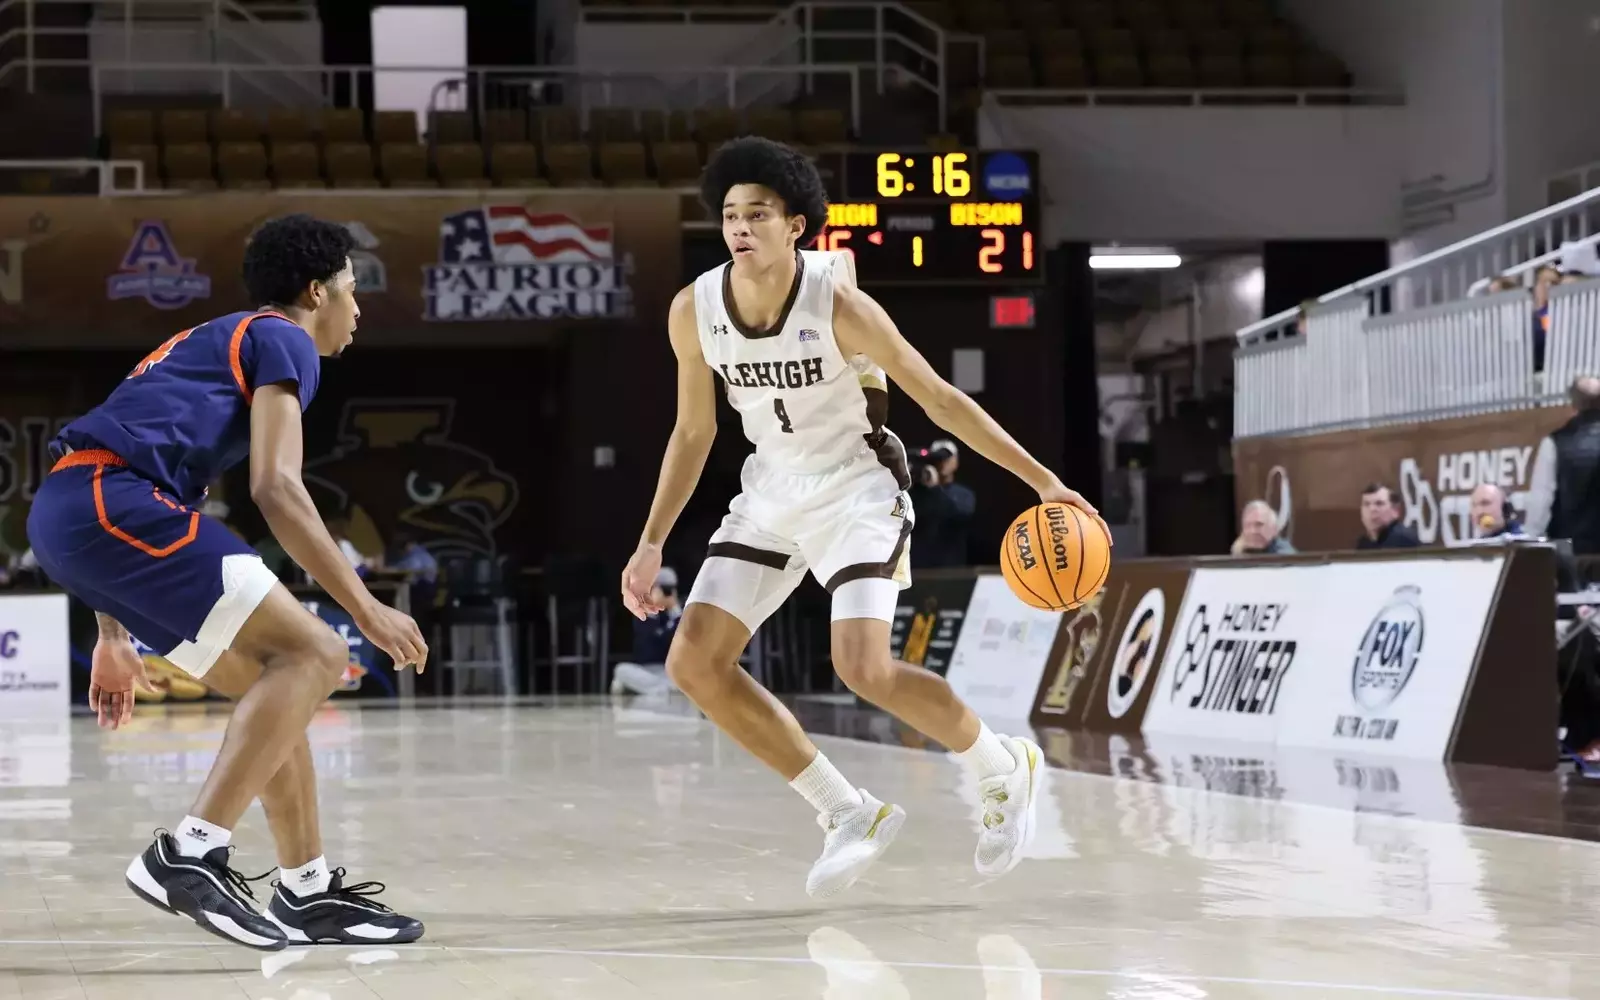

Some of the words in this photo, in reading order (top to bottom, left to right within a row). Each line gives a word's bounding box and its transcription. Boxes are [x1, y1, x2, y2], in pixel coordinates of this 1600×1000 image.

[877, 153, 970, 197] 6:16
[950, 203, 1022, 225] BISON
[912, 236, 923, 266] 1
[979, 229, 1032, 272] 21
[422, 263, 632, 292] PATRIOT
[422, 290, 634, 319] LEAGUE
[720, 357, 824, 389] LEHIGH
[774, 398, 794, 433] 4
[1438, 446, 1533, 492] HONEY
[1015, 521, 1037, 571] NCAA
[1044, 506, 1069, 571] Wilson
[1218, 602, 1288, 632] HONEY
[1366, 620, 1415, 668] FOX
[1189, 639, 1297, 715] STINGER
